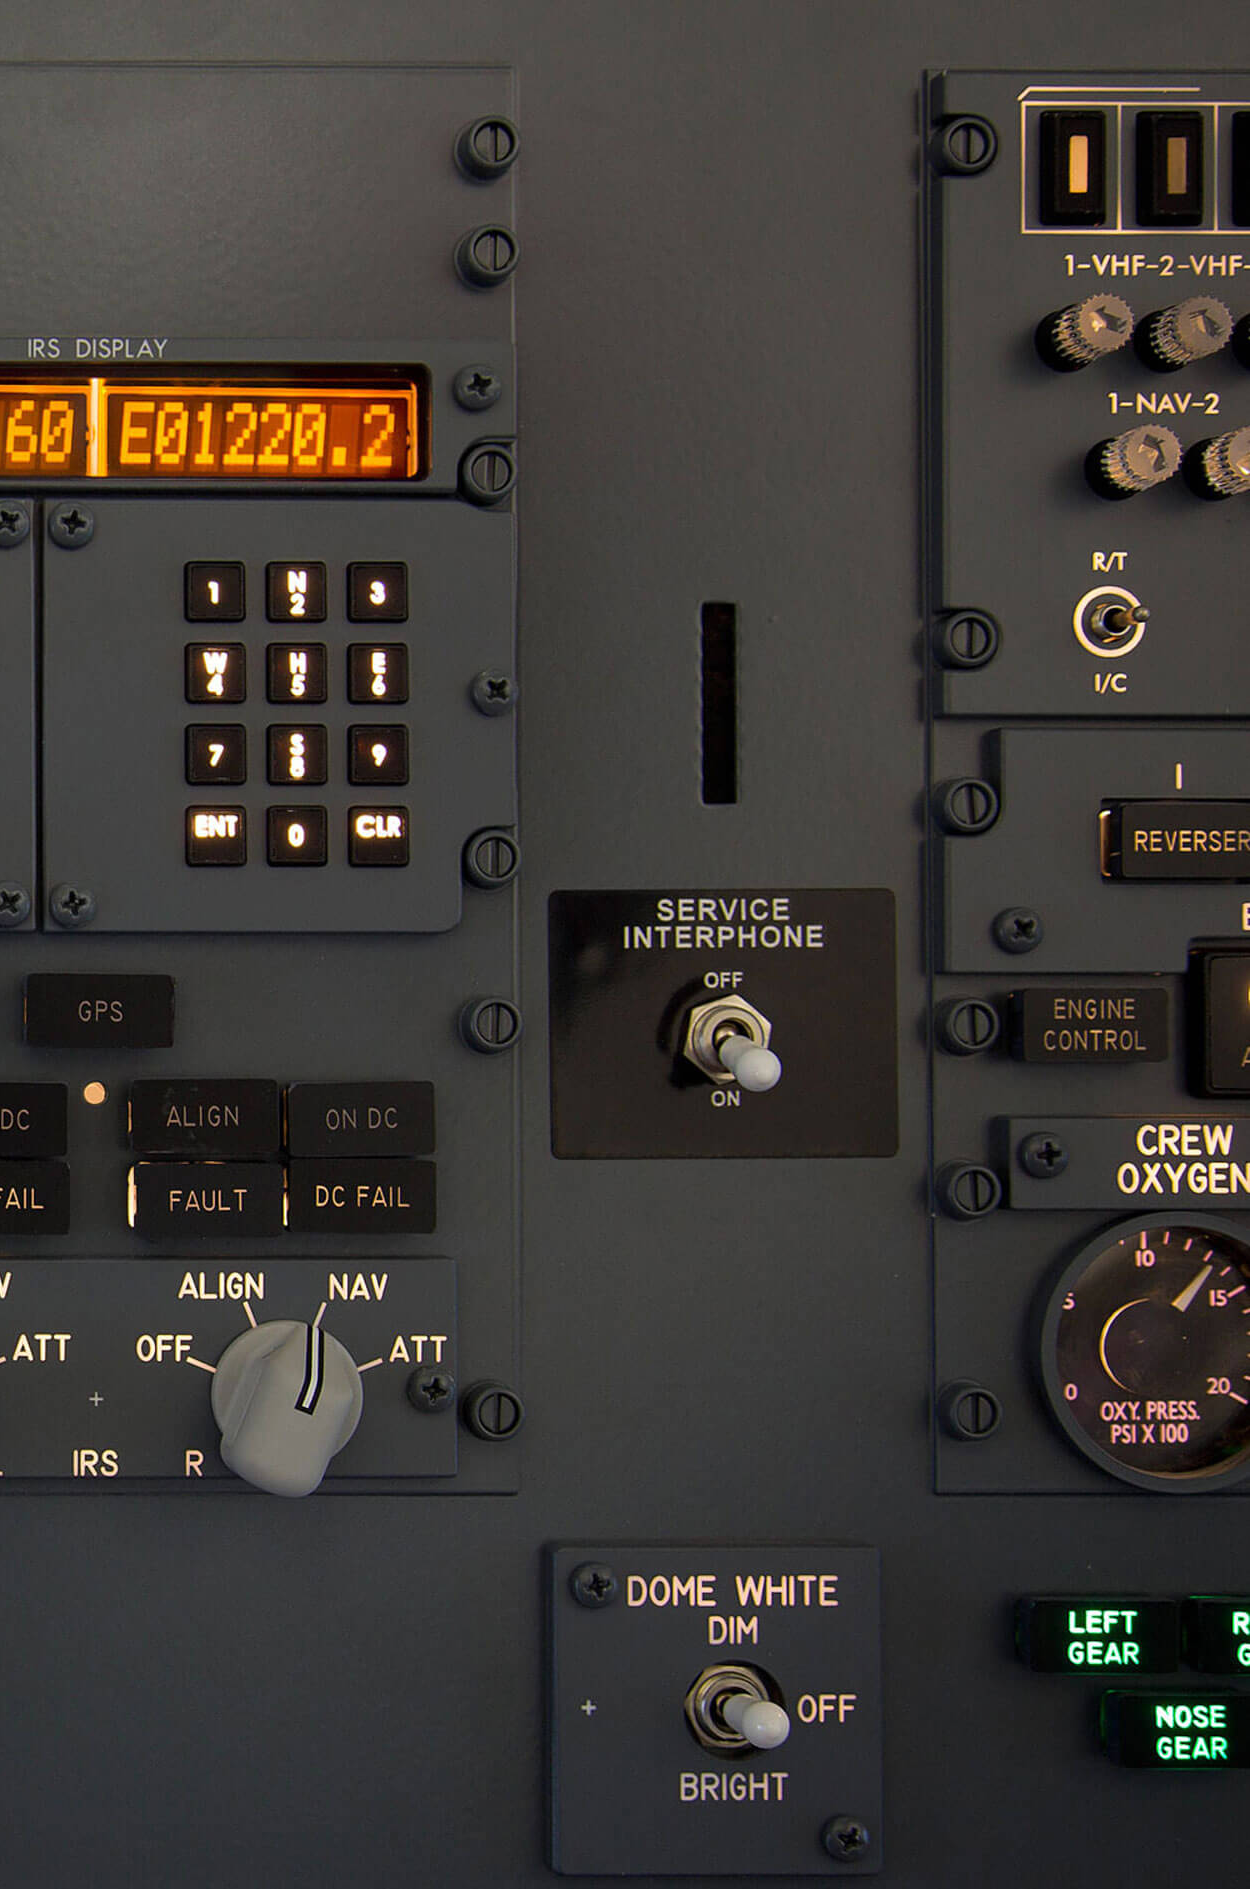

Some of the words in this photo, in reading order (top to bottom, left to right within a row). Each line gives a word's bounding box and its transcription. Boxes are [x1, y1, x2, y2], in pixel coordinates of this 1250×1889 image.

[28, 338, 60, 358] IRS
[76, 338, 167, 358] DISPLAY
[120, 401, 396, 468] E01220.2
[1093, 552, 1127, 572] R/T
[206, 580, 219, 605] 1
[287, 570, 307, 593] N
[369, 580, 386, 605] 3
[289, 593, 306, 617] 2
[202, 652, 228, 673] W
[289, 652, 307, 674] H
[371, 652, 386, 674] E
[206, 675, 224, 696] 4
[290, 677, 306, 696] 5
[371, 677, 386, 696] 6
[1095, 674, 1126, 693] I/C
[290, 733, 305, 755] S
[208, 744, 225, 767] 7
[371, 744, 388, 767] 9
[289, 756, 305, 778] 8
[193, 815, 238, 838] ENT
[287, 823, 305, 847] 0
[355, 815, 401, 839] CLR
[1135, 831, 1250, 851] REVERSER
[657, 898, 790, 921] SERVICE
[625, 925, 823, 948] INTERPHONE
[704, 972, 743, 988] OFF
[79, 1000, 122, 1022] GPS
[1055, 999, 1135, 1020] ENGINE
[1044, 1030, 1146, 1050] CONTROL
[711, 1091, 740, 1106] ON
[1, 1109, 29, 1130] DC
[167, 1106, 238, 1127] ALIGN
[326, 1109, 356, 1130] ON
[369, 1108, 397, 1128] DC
[1137, 1125, 1233, 1155] CREW
[1118, 1163, 1250, 1193] OXYGEN
[170, 1189, 247, 1211] FAULT
[316, 1185, 344, 1207] DC
[358, 1186, 409, 1207] FAIL
[1136, 1250, 1155, 1266] 10
[179, 1272, 263, 1299] ALIGN
[330, 1274, 387, 1300] NAV
[1210, 1290, 1227, 1306] 15
[13, 1334, 71, 1361] ATT
[137, 1335, 192, 1361] OFF
[390, 1336, 447, 1362] ATT
[1065, 1384, 1078, 1400] 0
[1207, 1378, 1230, 1394] 20
[1101, 1402, 1140, 1421] OXY.
[1146, 1401, 1200, 1420] PRESS.
[1111, 1424, 1136, 1443] PSI
[1142, 1424, 1155, 1443] X
[1161, 1423, 1189, 1443] 100
[74, 1450, 118, 1476] IRS
[186, 1450, 203, 1476] R
[628, 1576, 716, 1606] DOME
[736, 1576, 838, 1606] WHITE
[709, 1616, 758, 1644] DIM
[1068, 1610, 1137, 1634] LEFT
[1068, 1642, 1140, 1664] GEAR
[798, 1695, 856, 1722] OFF
[1155, 1705, 1226, 1728] NOSE
[1155, 1737, 1228, 1759] GEAR
[681, 1773, 788, 1801] BRIGHT
